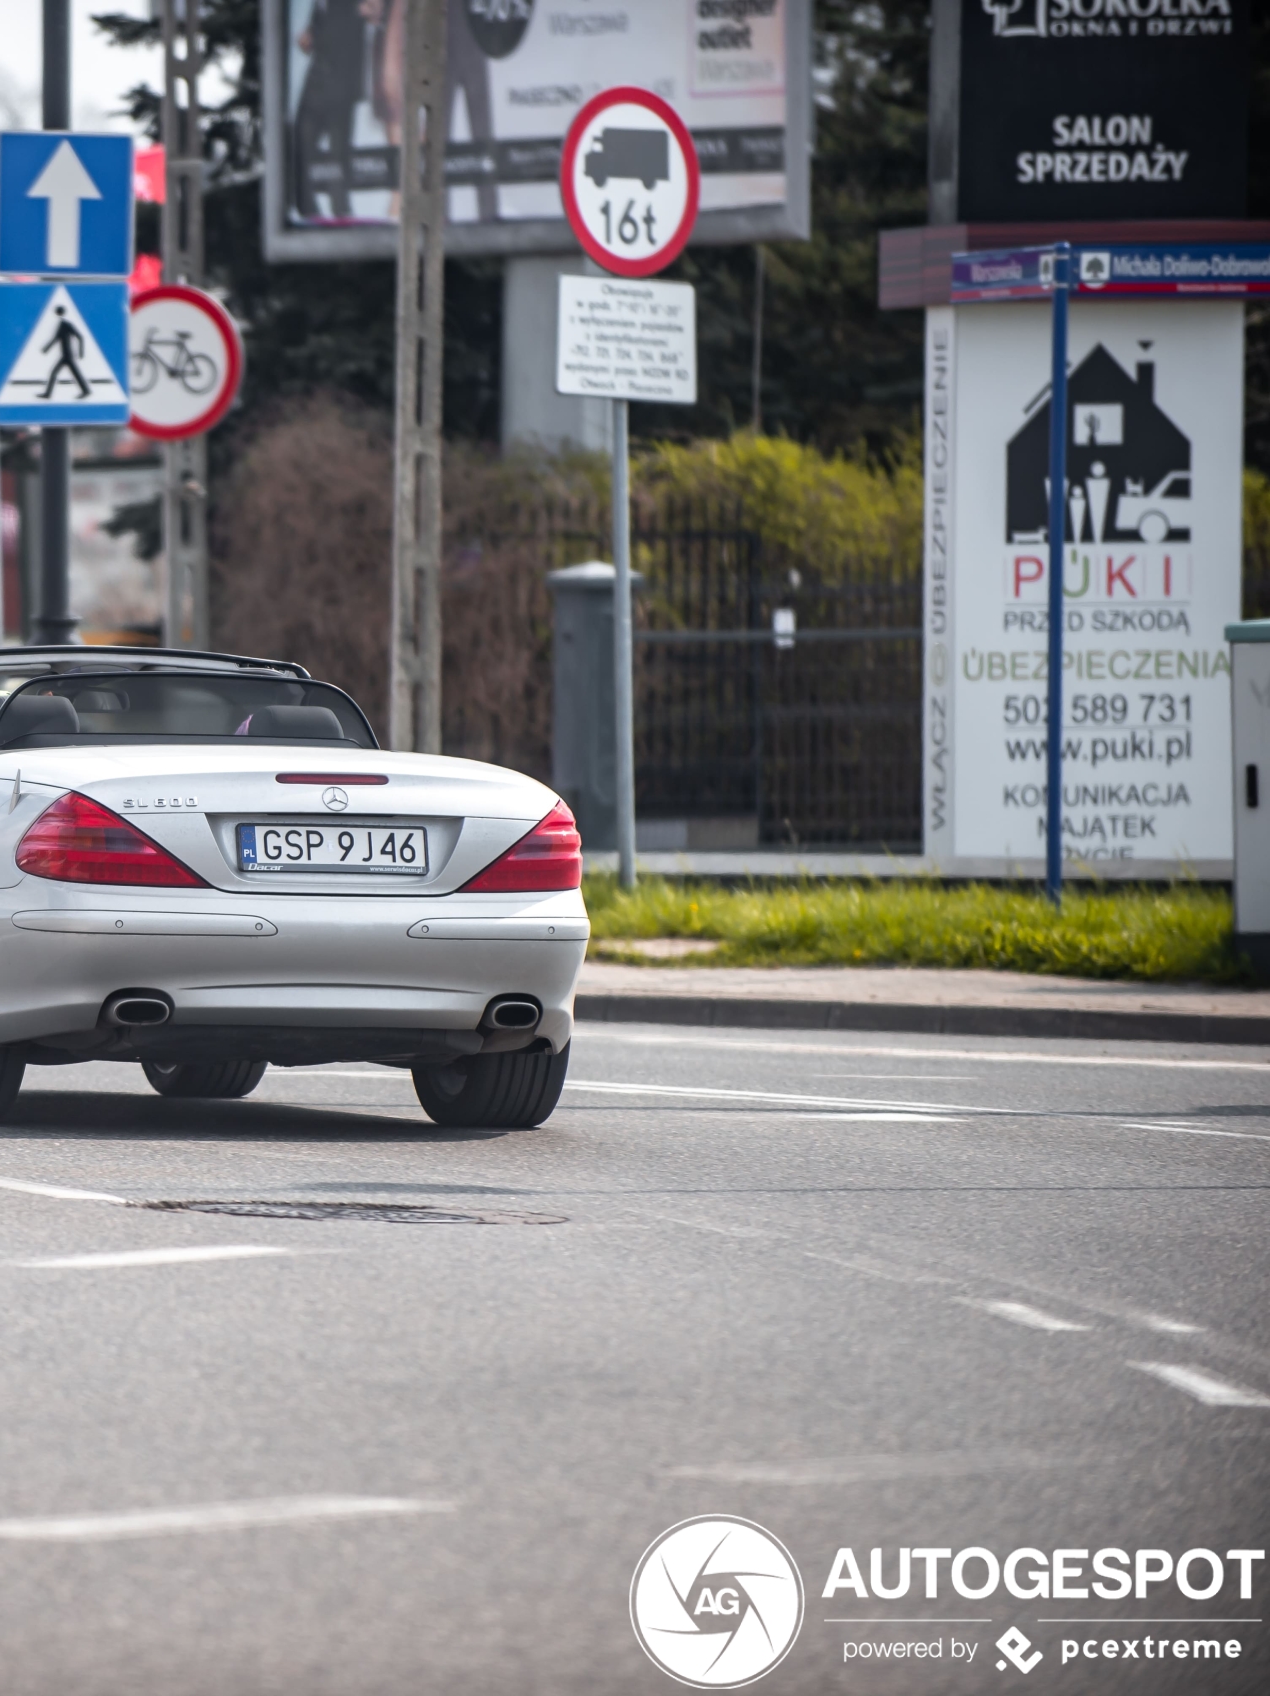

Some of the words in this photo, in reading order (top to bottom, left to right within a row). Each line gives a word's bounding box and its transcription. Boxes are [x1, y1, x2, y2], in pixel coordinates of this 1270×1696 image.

[1052, 115, 1152, 146] SALON
[1017, 143, 1189, 183] SPRZEDAŻY
[600, 199, 657, 246] 16t
[1003, 610, 1084, 633] PRZD
[1071, 695, 1127, 724] 589
[1138, 694, 1192, 722] 731
[123, 798, 148, 808] SL
[154, 797, 198, 808] 600
[1003, 784, 1191, 808] KOUNIKACJA
[243, 849, 255, 857] PL
[264, 830, 324, 861] GSP
[338, 831, 416, 863] 9J46
[248, 863, 283, 871] Dacar
